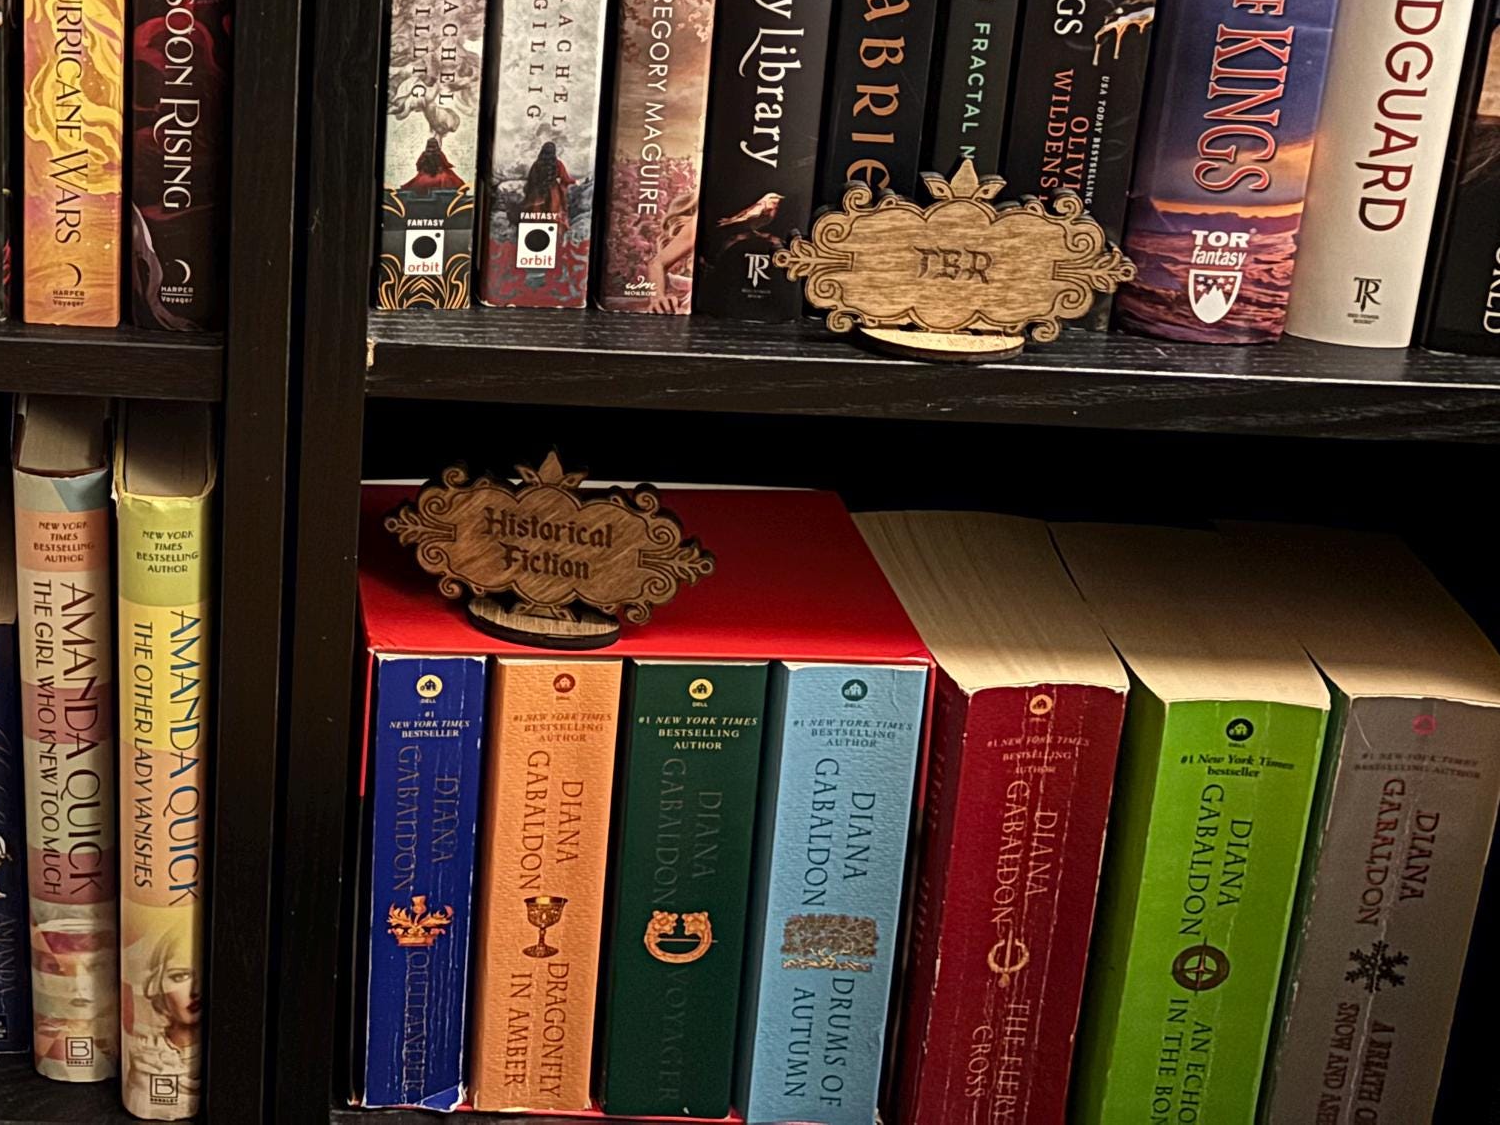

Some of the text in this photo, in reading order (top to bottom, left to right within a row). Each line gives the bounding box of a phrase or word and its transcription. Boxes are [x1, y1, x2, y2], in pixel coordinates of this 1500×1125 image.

[961, 20, 992, 133] FRACTAL
[738, 26, 806, 171] Library
[1191, 23, 1295, 194] KINGS
[637, 101, 668, 217] MAGUIRE
[47, 147, 90, 245] WARS
[406, 218, 445, 227] FANTASY
[520, 211, 559, 221] FANTASY
[1190, 230, 1249, 248] TOR
[407, 260, 441, 274] orbit
[519, 252, 553, 268] orbit
[1190, 248, 1247, 269] fantasy
[39, 521, 90, 531] NEW YORK
[482, 506, 614, 549] Historical
[49, 532, 79, 542] TIMES
[142, 530, 193, 540] NEW YORK
[32, 541, 95, 552] BESTSELLING
[154, 542, 183, 551] TIMES
[44, 553, 85, 564] AUTHOR
[136, 551, 199, 562] BESTSELLING
[497, 541, 591, 580] Fiction
[147, 563, 188, 574] AUTHOR
[638, 716, 759, 727] #1 NEW YORK TIMES
[59, 581, 103, 895] AMANDA QUICK
[401, 729, 460, 739] BESTSELLER
[658, 728, 741, 739] BESTSELLING
[673, 740, 723, 751] AUTHOR
[132, 621, 154, 888] THE OTHER LADY VANISHES
[1207, 766, 1261, 778] bestseller
[519, 750, 552, 892] GABALDON
[556, 779, 585, 865] DIANA
[800, 757, 840, 907] GABALDON
[843, 791, 876, 881] DIANA
[1178, 784, 1224, 937] GABALDON
[1217, 819, 1252, 908] DIANA
